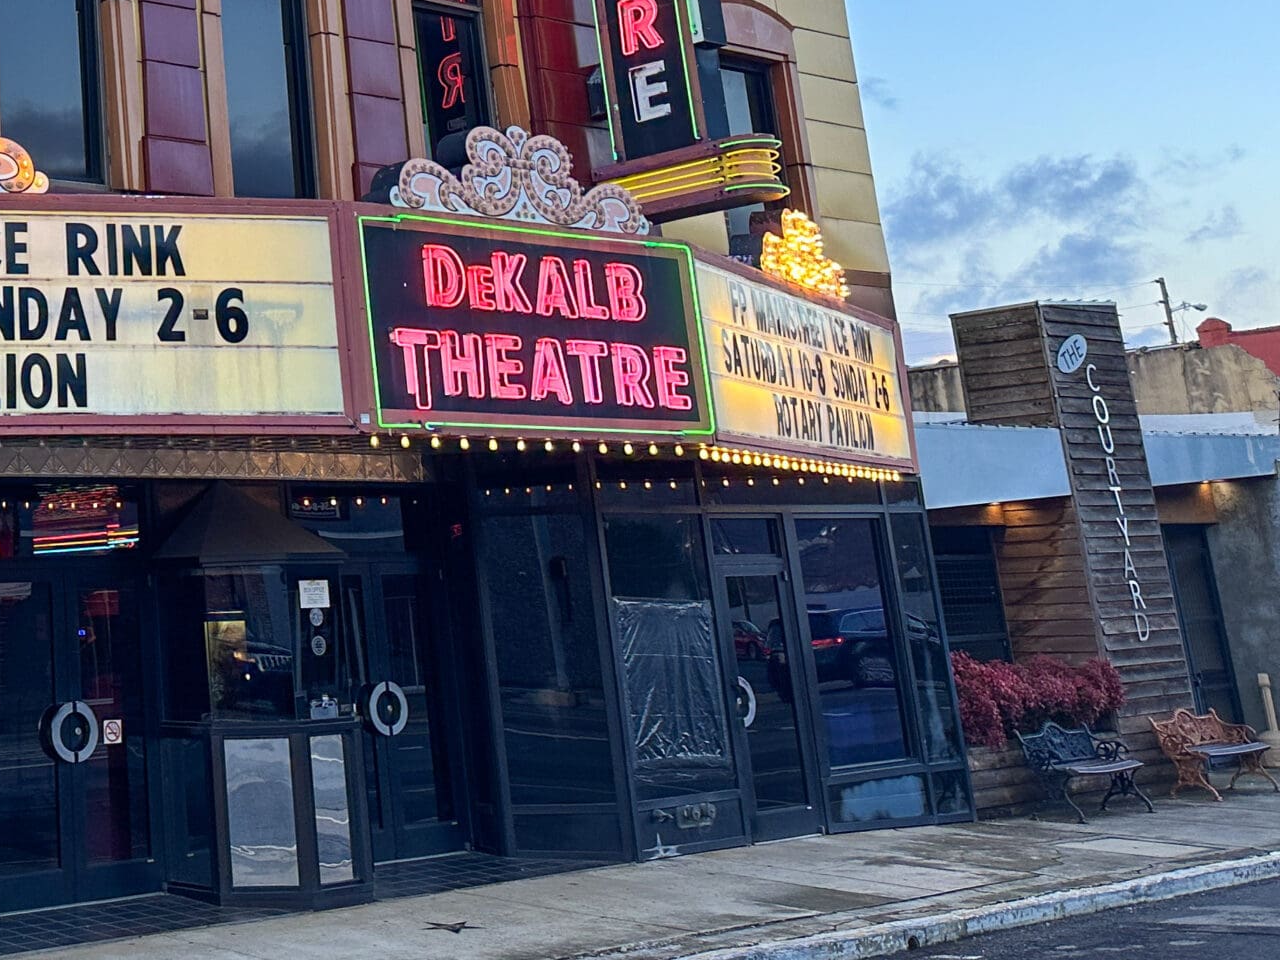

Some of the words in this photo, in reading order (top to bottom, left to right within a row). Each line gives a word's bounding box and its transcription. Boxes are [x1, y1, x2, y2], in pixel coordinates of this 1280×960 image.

[66, 222, 186, 277] RINK
[157, 288, 249, 343] 2-6
[728, 280, 747, 327] FP
[750, 287, 829, 352] MAINSTREET
[828, 315, 850, 357] ICE
[850, 322, 874, 365] RINK
[389, 327, 693, 411] THEATRE
[721, 329, 795, 389] SATURDAY
[830, 359, 871, 406] SUNDAY
[871, 372, 890, 412] 2-6
[1061, 339, 1084, 369] THE
[773, 394, 823, 443] ROTARY
[827, 404, 875, 451] PAVILION
[1086, 363, 1149, 641] COURTYARD
